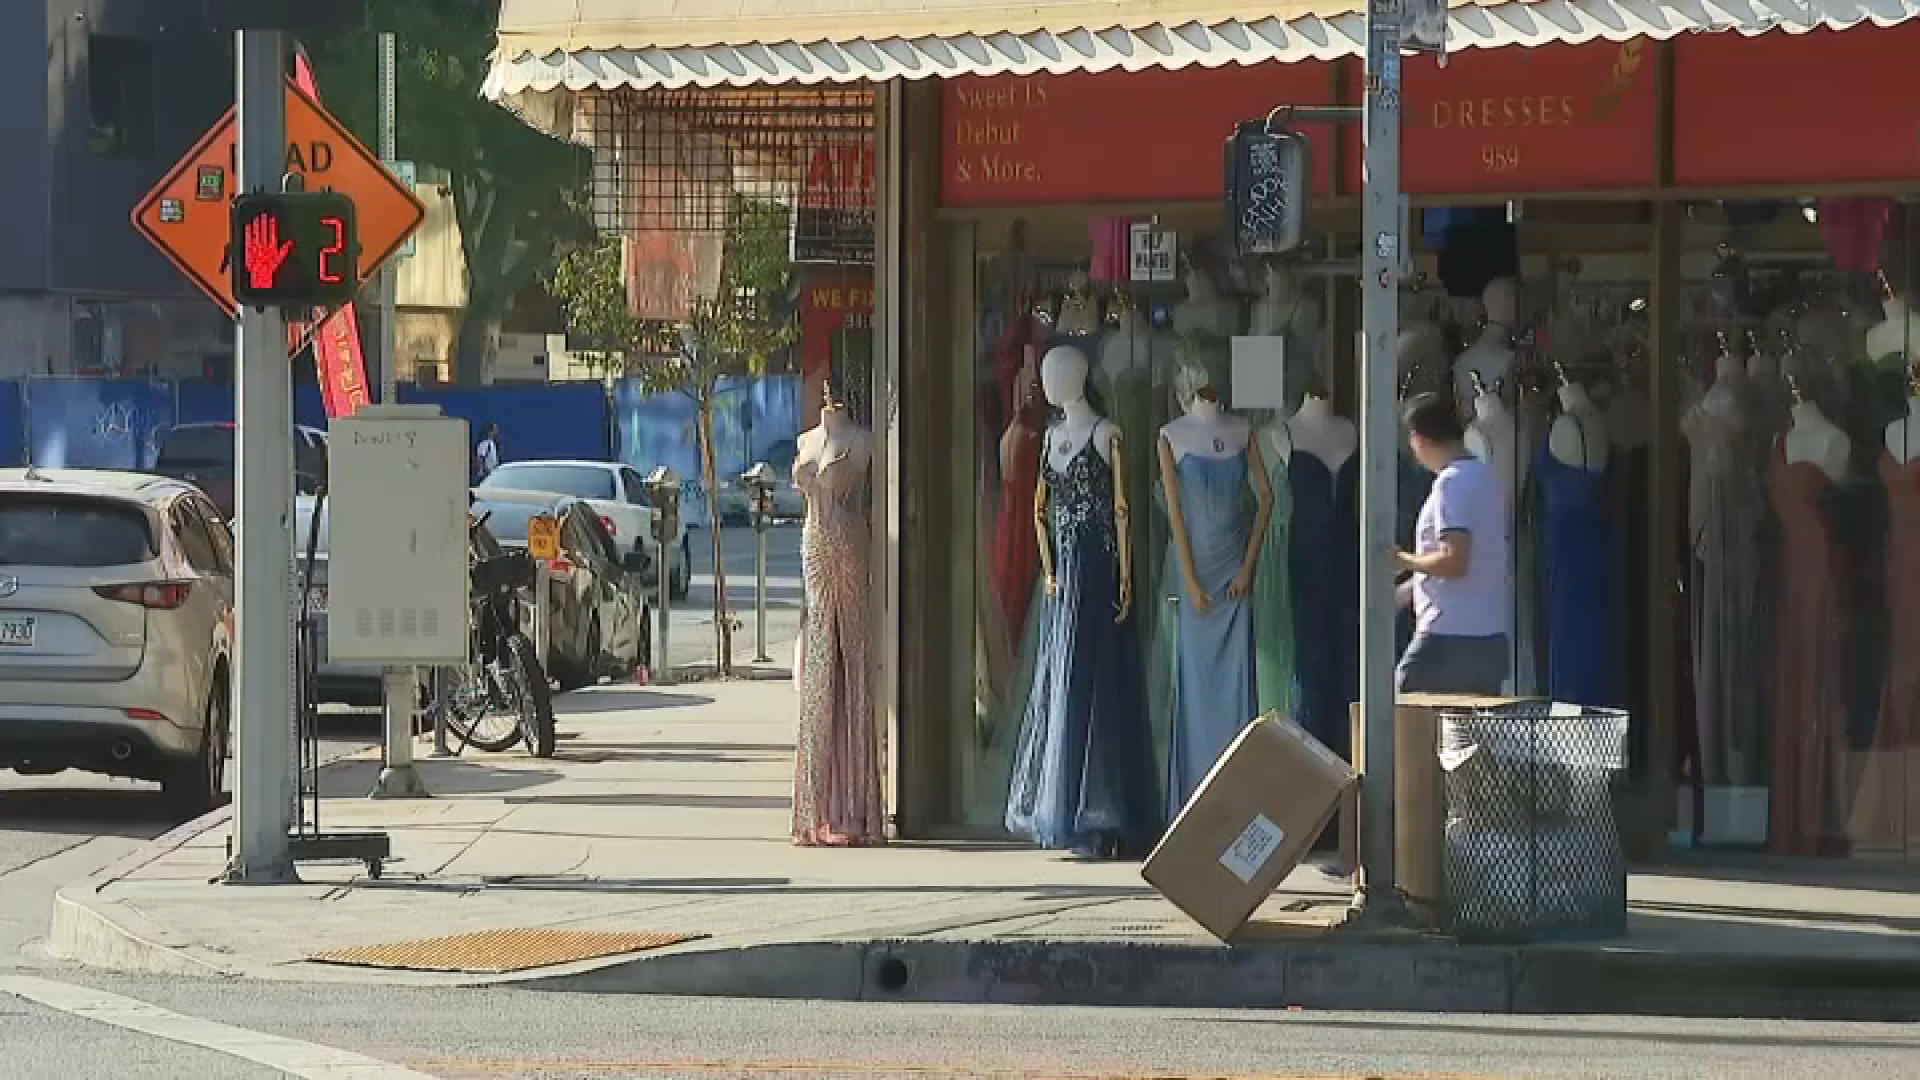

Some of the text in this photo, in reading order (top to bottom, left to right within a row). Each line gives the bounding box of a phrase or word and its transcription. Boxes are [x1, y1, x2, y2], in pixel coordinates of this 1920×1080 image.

[1433, 96, 1573, 129] DRESSES
[956, 117, 1020, 145] Debut
[956, 153, 1042, 183] & More.
[1481, 143, 1519, 173] 959
[319, 216, 343, 283] 2
[812, 287, 842, 308] WE
